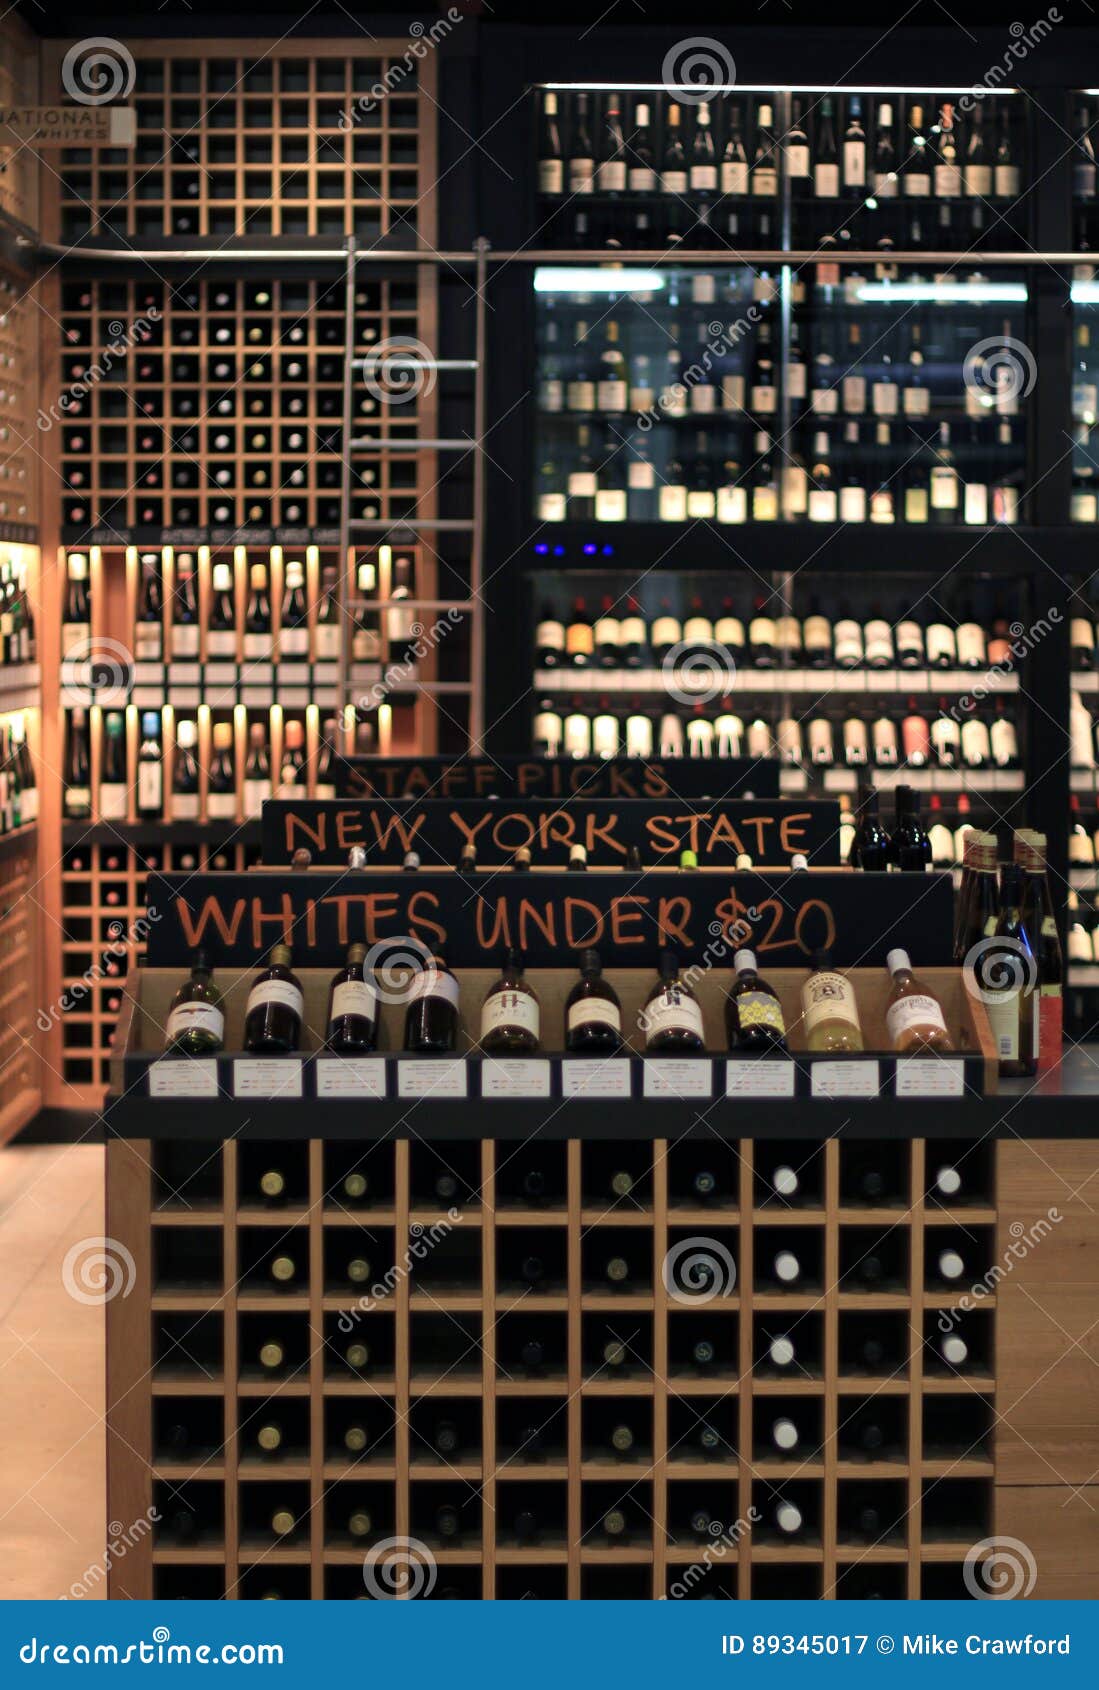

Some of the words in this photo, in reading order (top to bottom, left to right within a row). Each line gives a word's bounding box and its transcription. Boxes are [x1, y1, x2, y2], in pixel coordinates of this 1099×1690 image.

[35, 129, 107, 139] WHITES
[347, 764, 498, 798] STAFF
[517, 763, 669, 797] PICKS
[285, 810, 427, 852] NEW
[450, 810, 631, 854] YORK
[646, 812, 812, 855] STATE
[176, 891, 447, 948] WHITES
[475, 895, 694, 950] UNDER
[714, 886, 836, 955] $20
